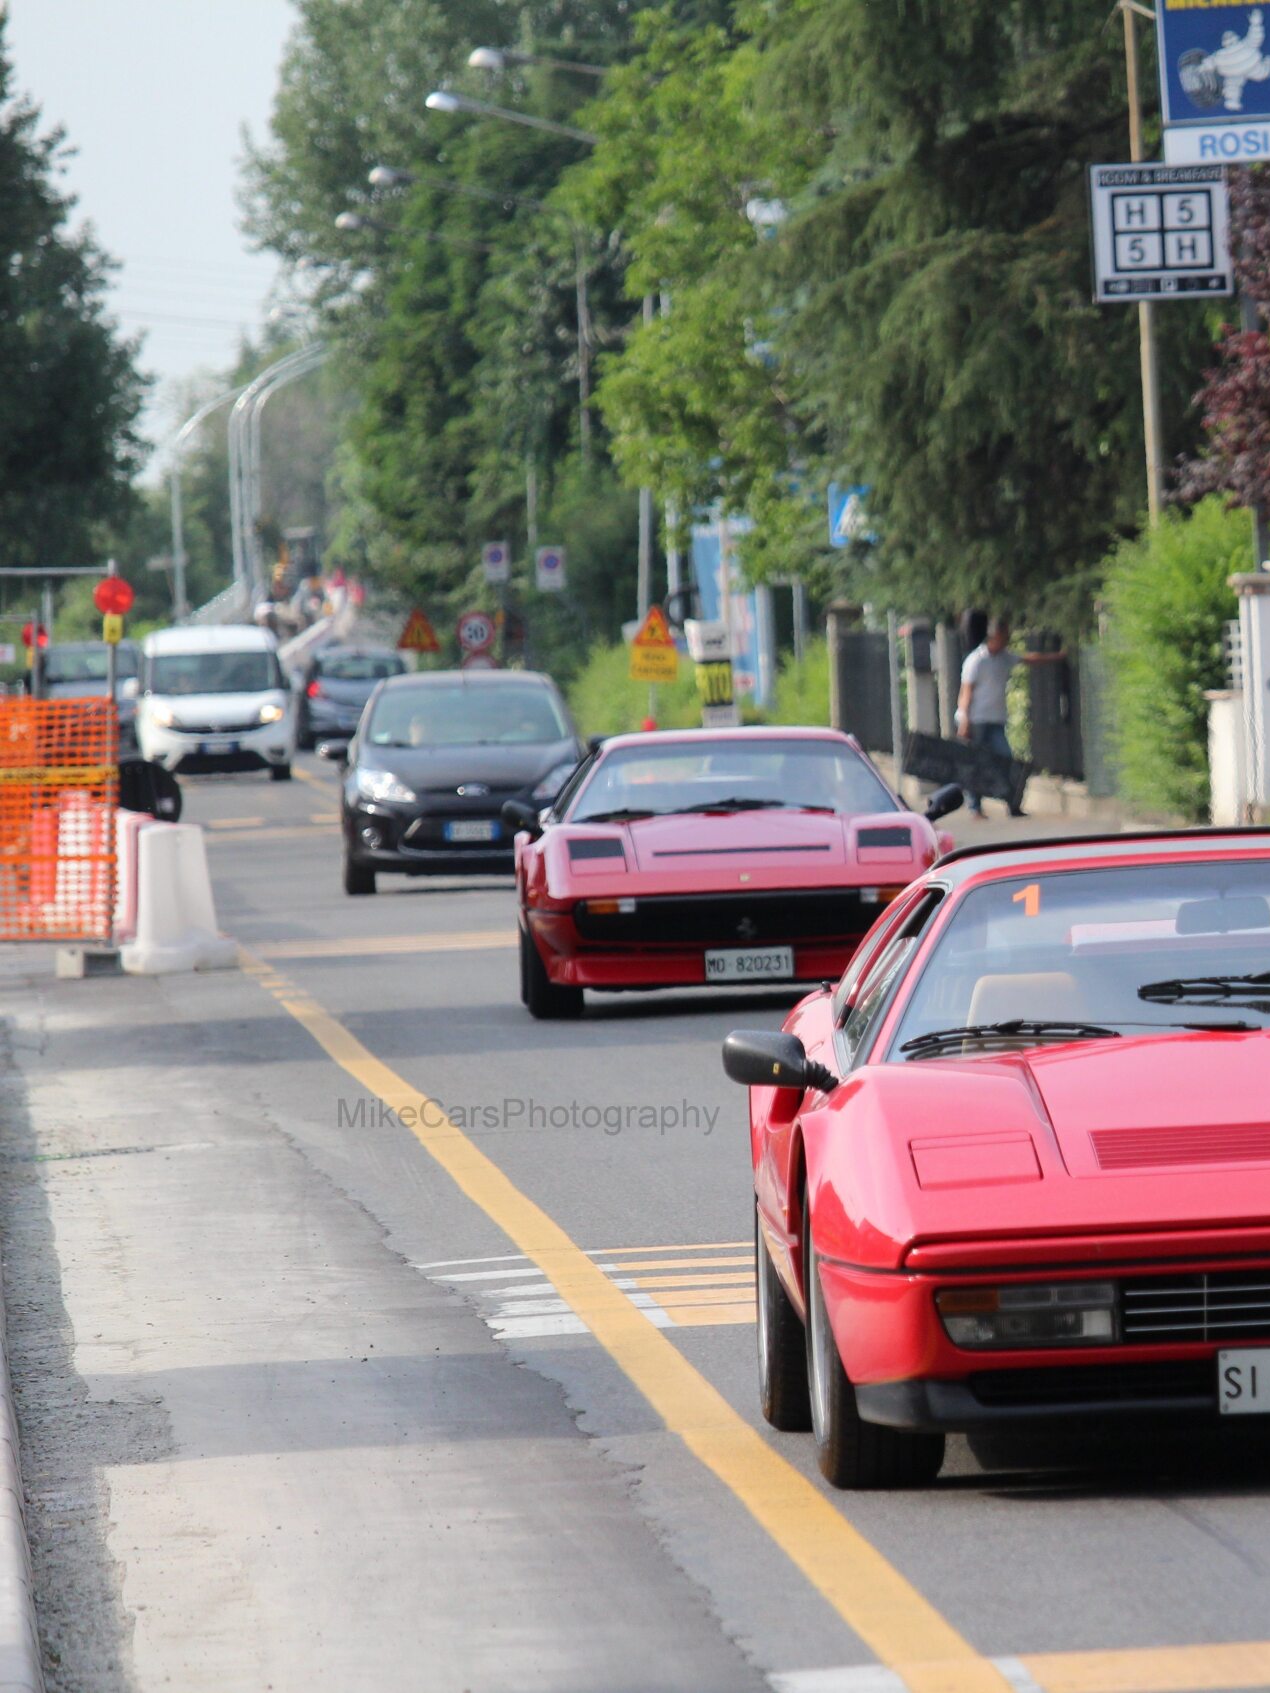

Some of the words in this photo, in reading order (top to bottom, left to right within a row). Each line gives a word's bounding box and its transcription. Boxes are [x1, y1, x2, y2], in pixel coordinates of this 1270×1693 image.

[1199, 129, 1270, 158] ROSI
[1124, 200, 1147, 226] H
[1176, 197, 1194, 224] 5
[1128, 237, 1147, 264] 5
[1177, 235, 1198, 261] H
[1012, 883, 1041, 917] 1
[735, 954, 790, 973] 820231
[1223, 1366, 1257, 1400] SI
